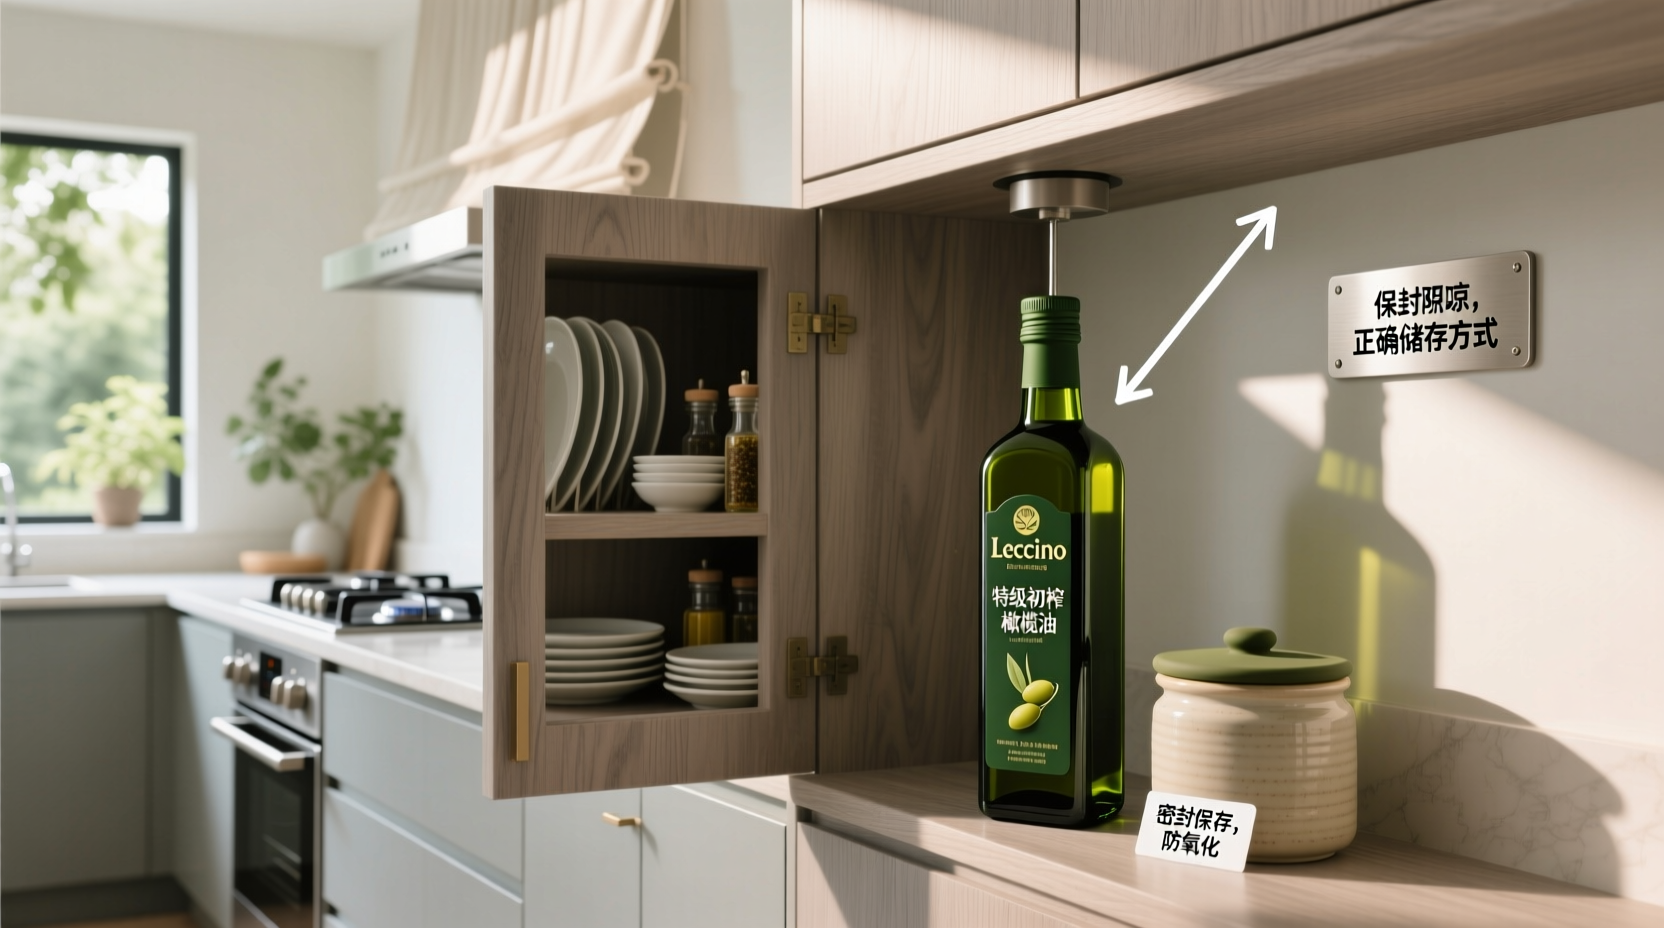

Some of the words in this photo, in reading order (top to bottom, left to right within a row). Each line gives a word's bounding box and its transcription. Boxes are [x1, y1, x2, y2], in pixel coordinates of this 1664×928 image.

[1353, 316, 1498, 355] 正确储存方式
[990, 536, 1067, 560] Leccino
[992, 585, 1065, 610] 特级初榨
[1001, 610, 1057, 634] 橄榄油
[1156, 803, 1239, 835] 密封保存，
[1161, 830, 1221, 858] 防氧化
